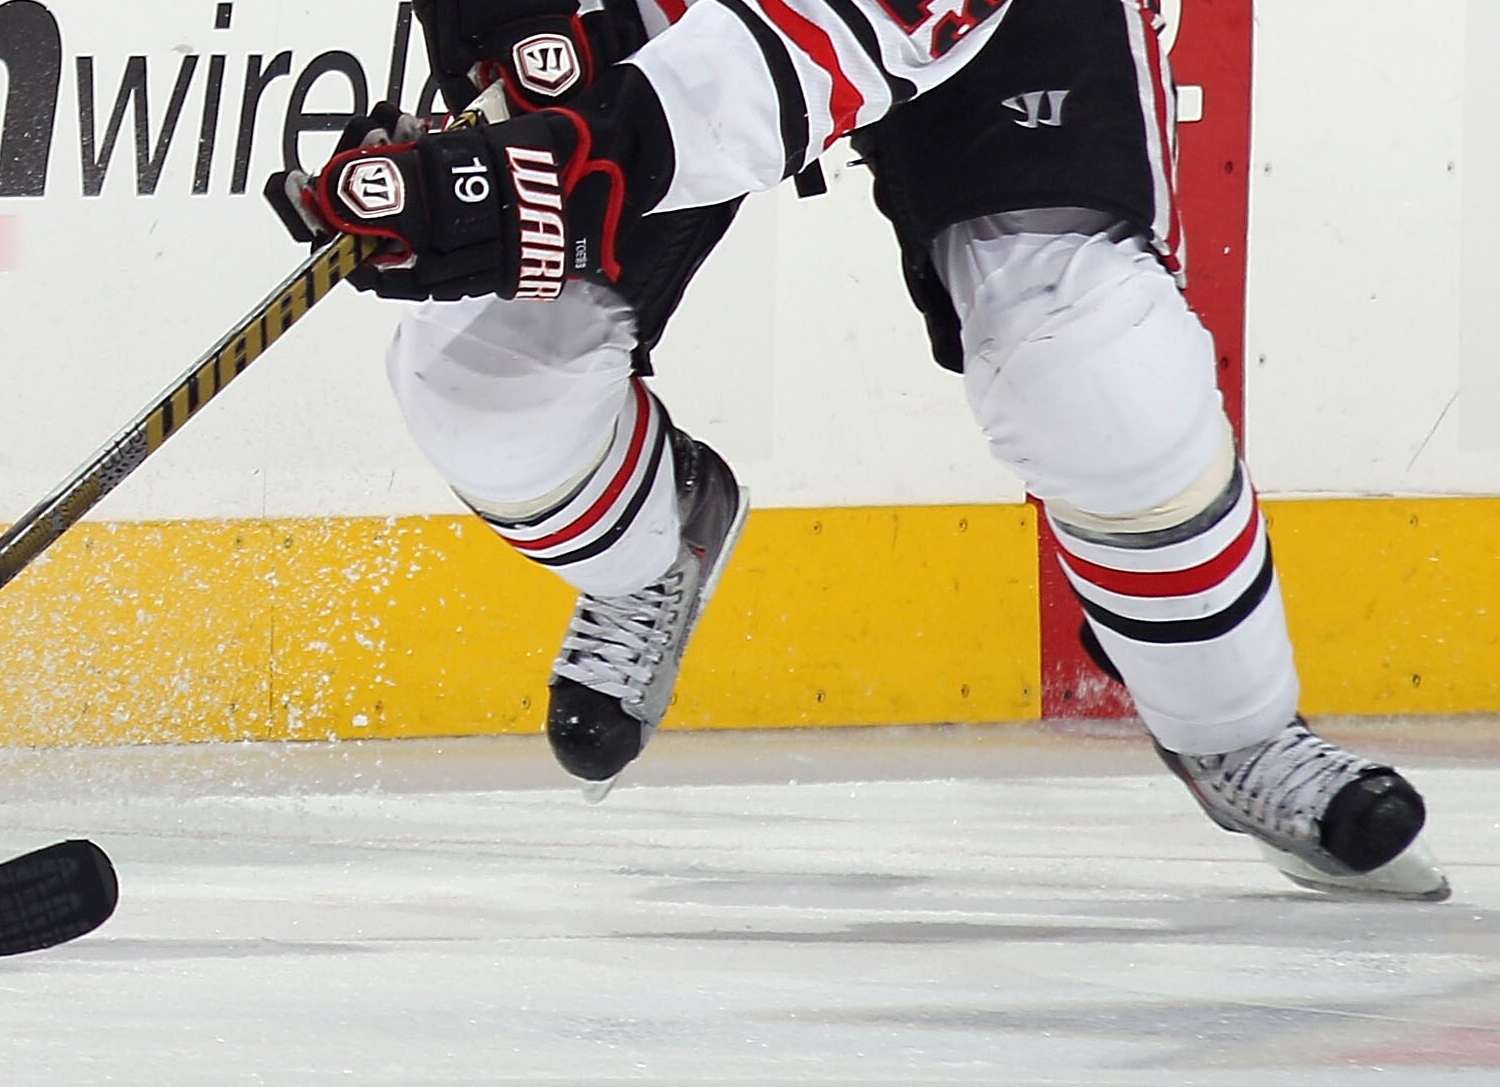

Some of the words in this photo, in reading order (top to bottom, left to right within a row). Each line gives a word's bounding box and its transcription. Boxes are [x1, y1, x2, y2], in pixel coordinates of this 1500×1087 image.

[73, 0, 450, 198] wirel
[451, 156, 490, 204] 19
[505, 145, 565, 302] WARR
[145, 233, 378, 456] WARR
